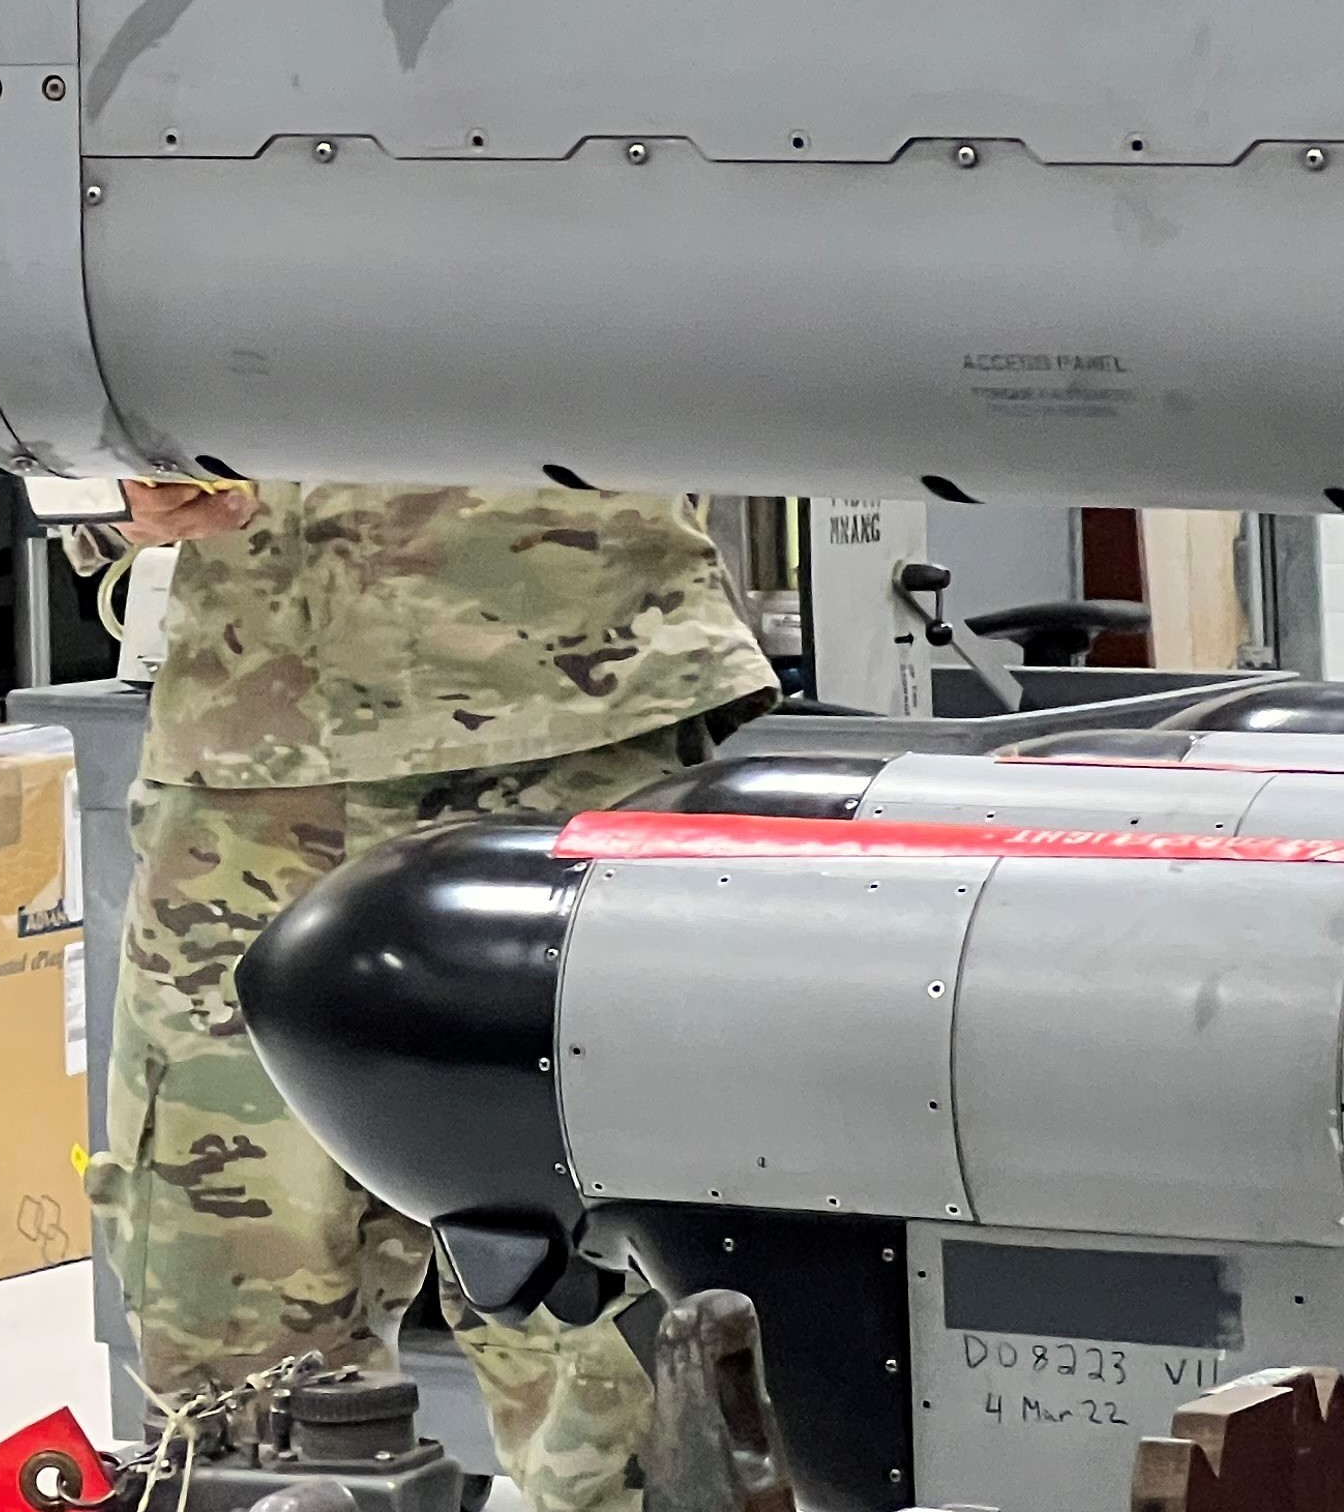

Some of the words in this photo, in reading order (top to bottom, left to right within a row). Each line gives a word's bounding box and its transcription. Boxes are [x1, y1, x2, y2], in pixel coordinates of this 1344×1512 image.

[963, 1334, 1127, 1386] D08223
[985, 1391, 1003, 1425] 4
[1081, 1398, 1130, 1426] 22
